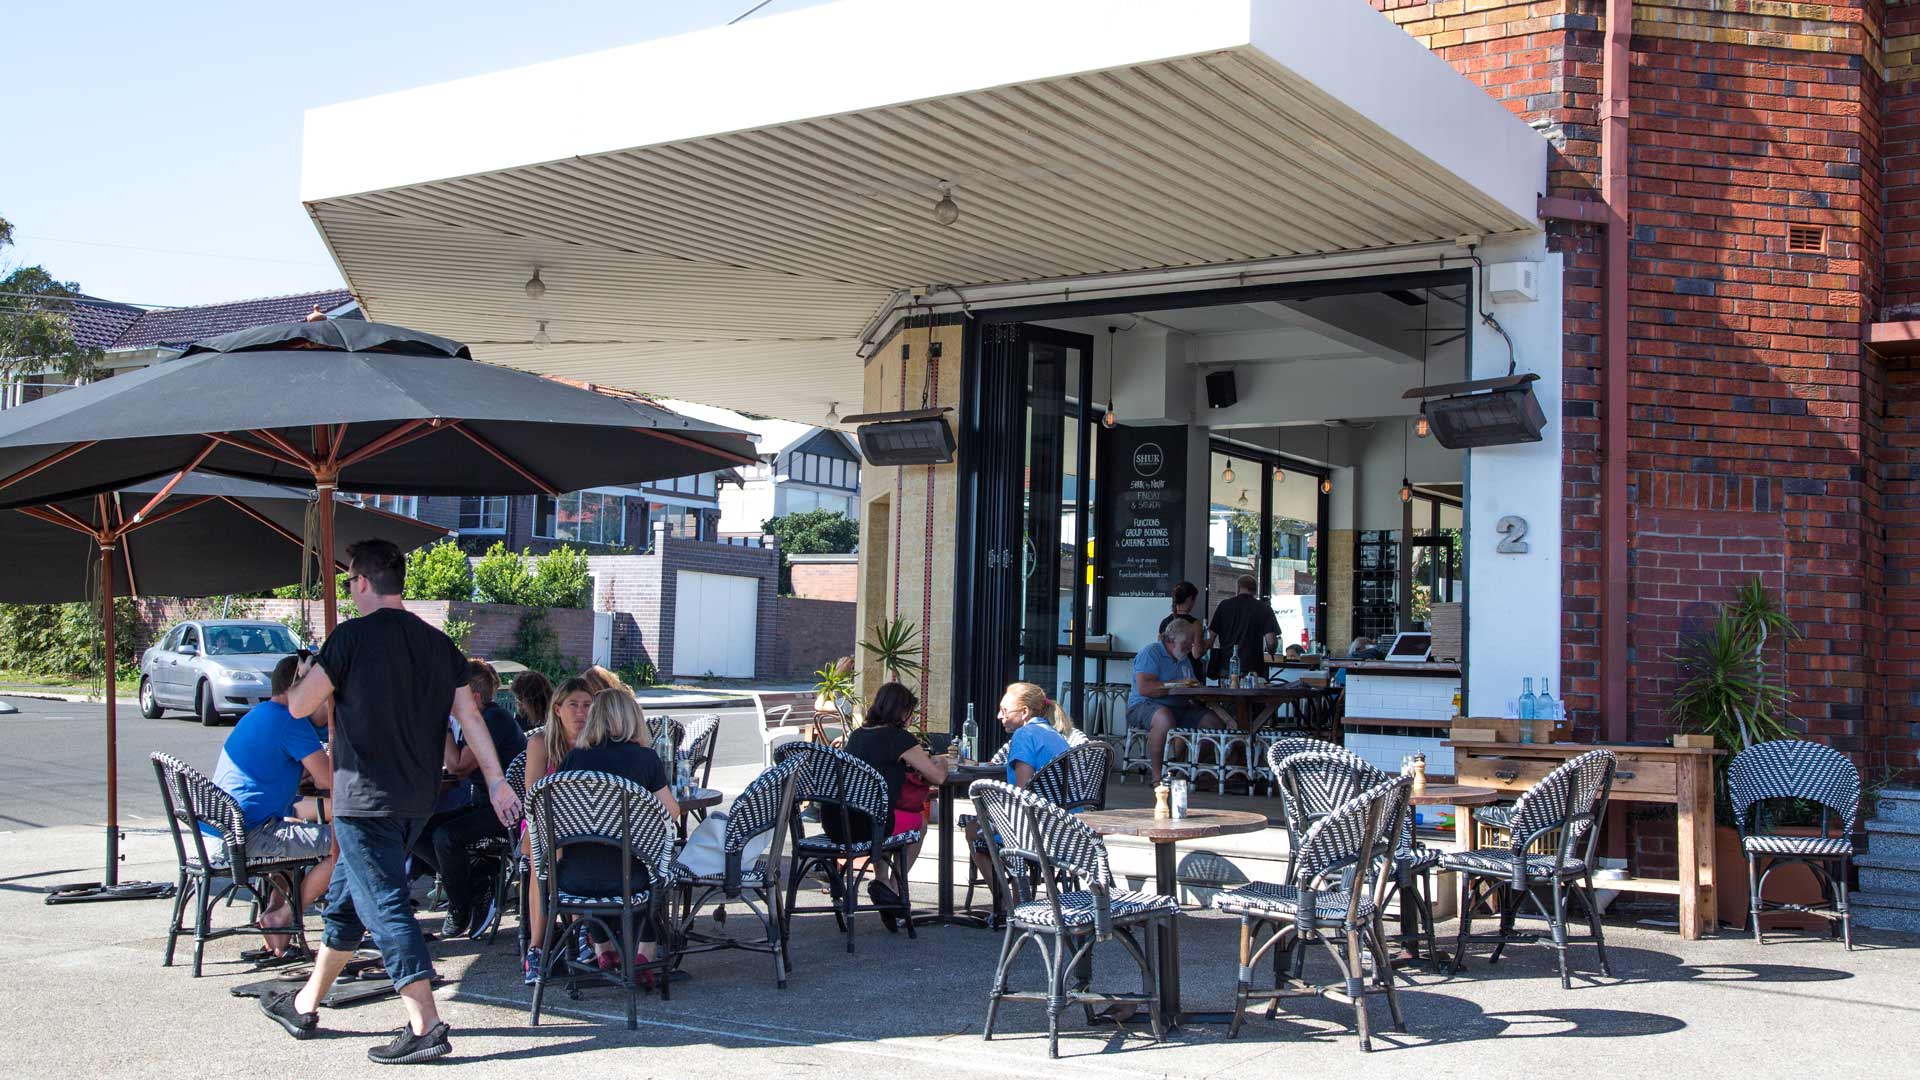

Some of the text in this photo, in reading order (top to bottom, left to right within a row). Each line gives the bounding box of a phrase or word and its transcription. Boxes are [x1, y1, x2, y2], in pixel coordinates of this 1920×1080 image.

[1136, 454, 1160, 463] SHUK
[1133, 518, 1160, 527] FUNCTIONS
[1125, 528, 1168, 537] GROUP BOOKINGS
[1496, 515, 1528, 554] 2
[1121, 538, 1145, 547] CATERING
[1146, 538, 1170, 547] SERVICES
